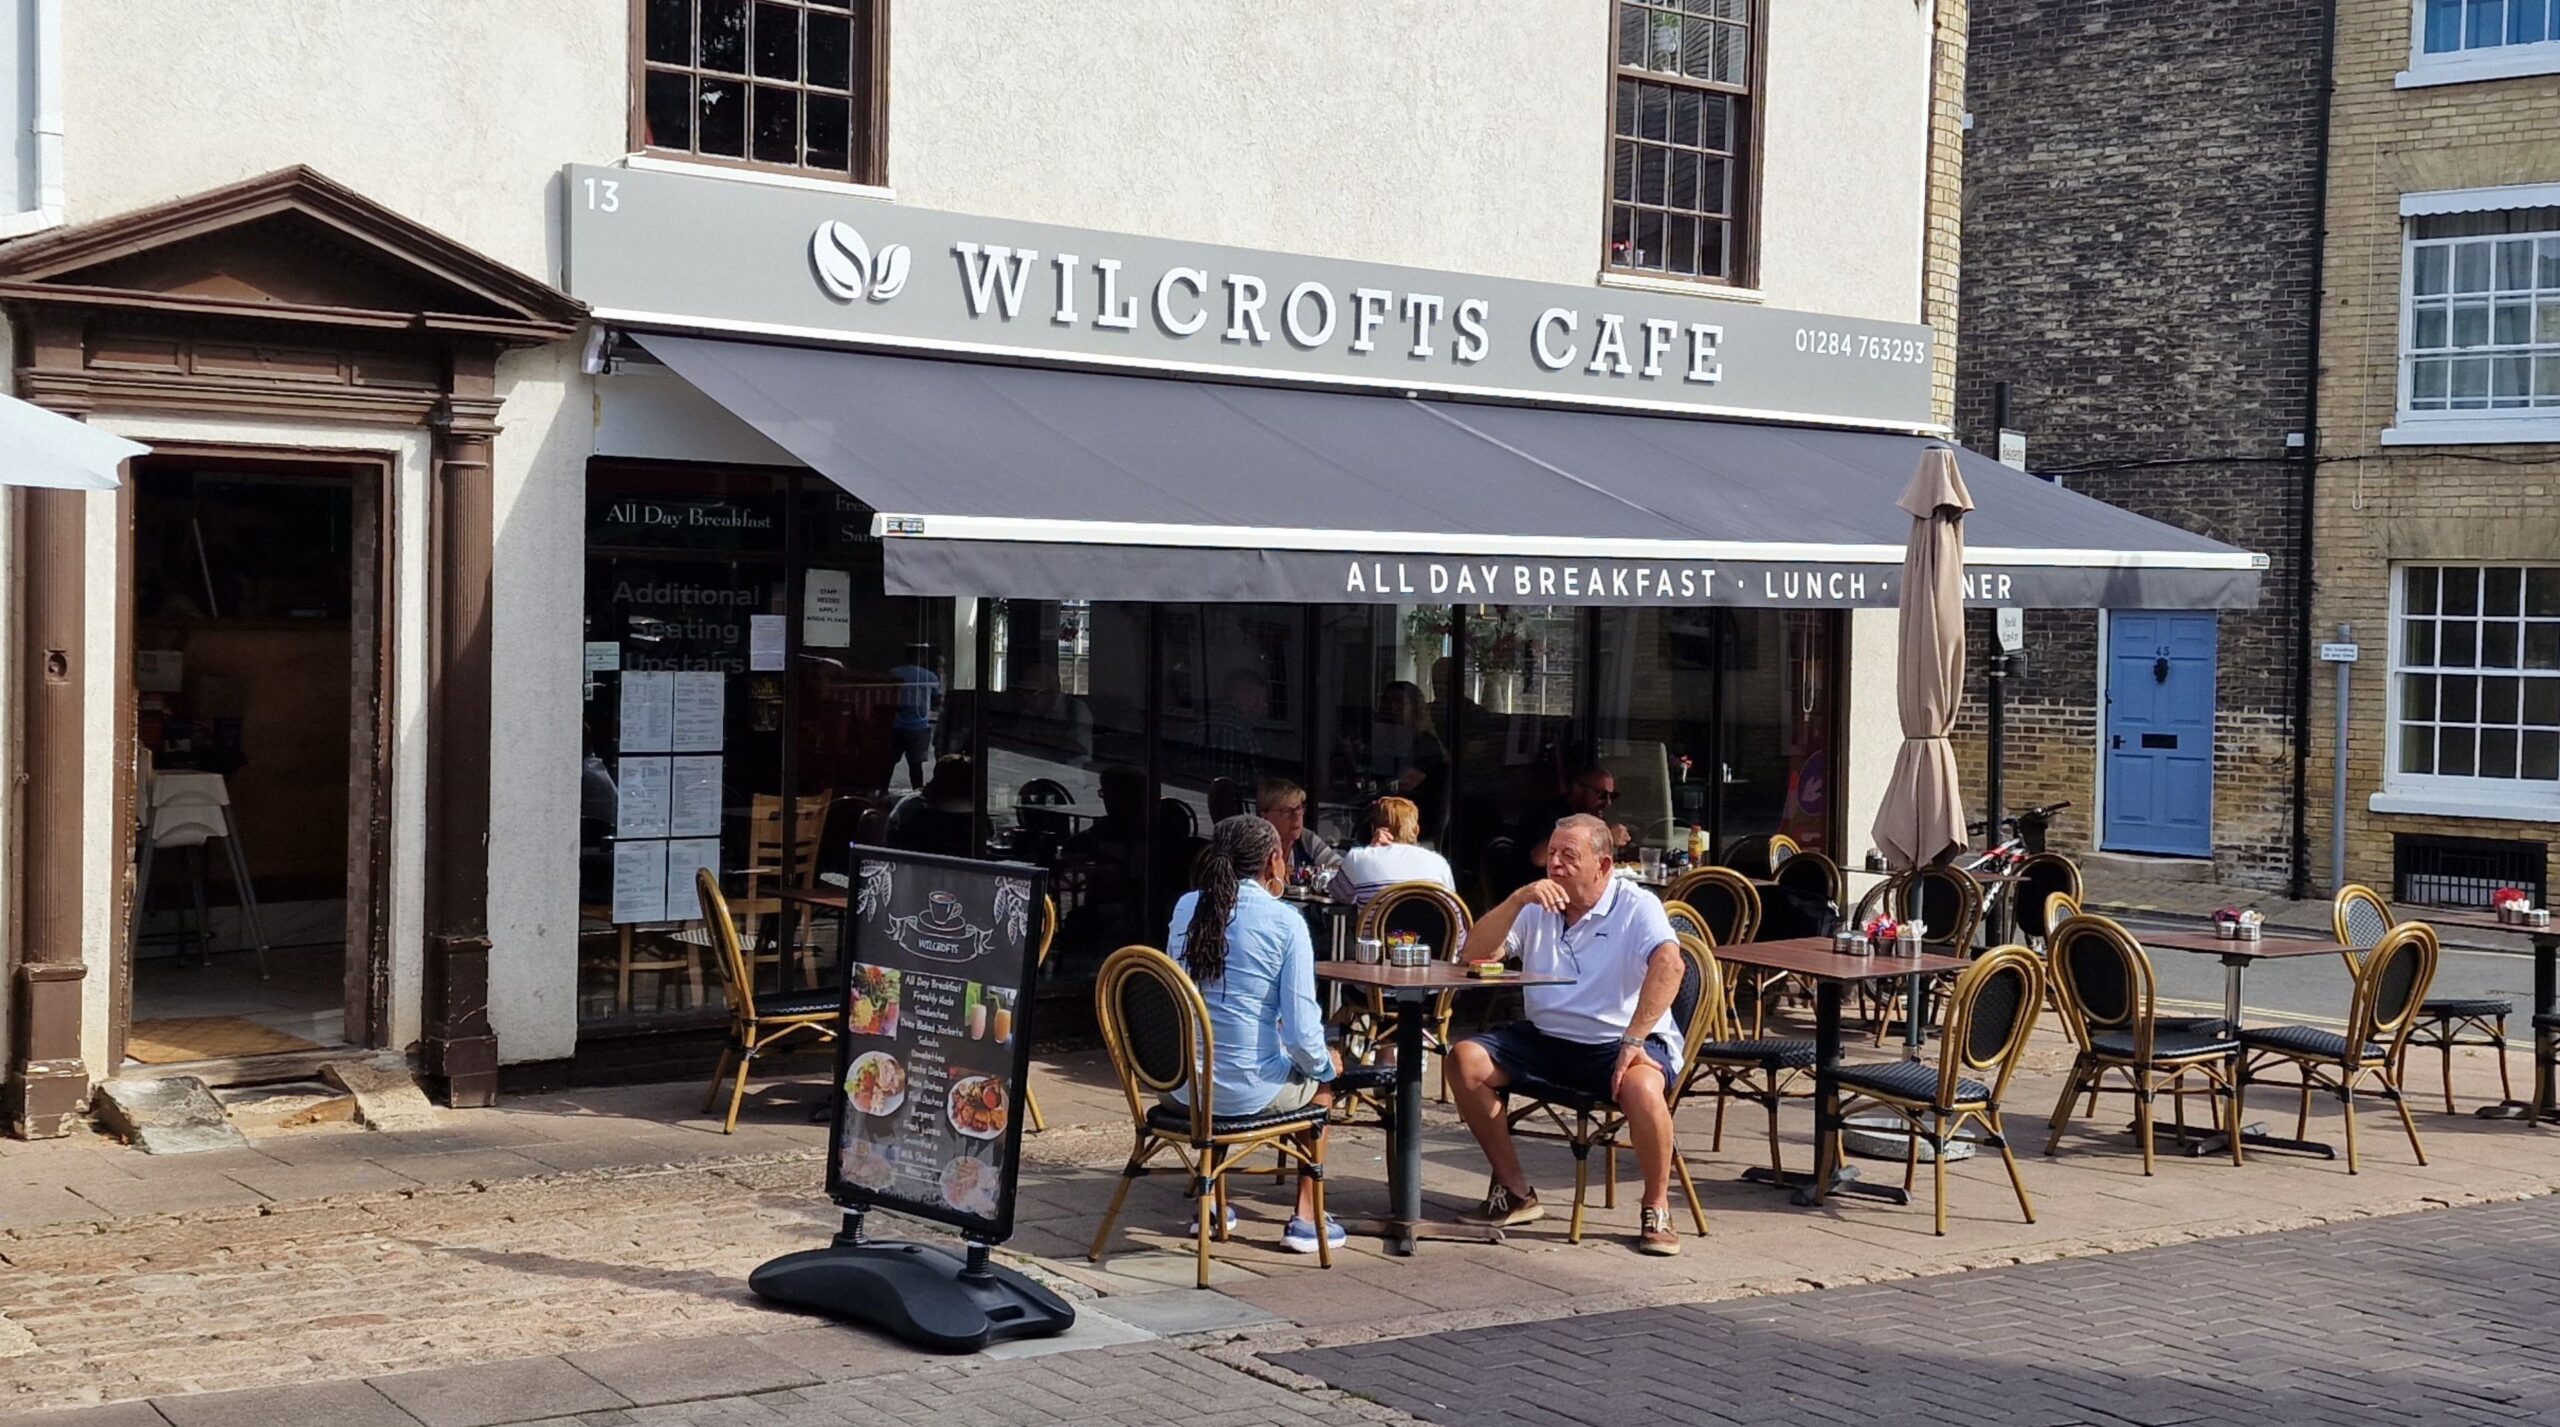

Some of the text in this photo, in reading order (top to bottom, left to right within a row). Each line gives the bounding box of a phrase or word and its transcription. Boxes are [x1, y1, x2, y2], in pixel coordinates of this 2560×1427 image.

[583, 178, 619, 212] 13
[954, 241, 1724, 384] WILCROFTS CAFE
[1795, 328, 1926, 365] 01284 763293
[606, 503, 772, 528] All Day Breakfast
[1347, 562, 1414, 593] ALL
[1429, 564, 1499, 594] DAY
[1514, 565, 1717, 597] BREAKFAST
[1766, 571, 1866, 599] LUNCH
[612, 582, 759, 606] Additional
[629, 617, 740, 644] Seating
[2155, 646, 2170, 656] 45
[624, 652, 745, 674] Upstairs
[918, 939, 959, 954] WILCROFTS
[905, 975, 962, 993] All Day Breakfast
[913, 990, 938, 1006] Freshly
[914, 1005, 949, 1020] Sandwiches
[917, 1035, 940, 1048] Salads
